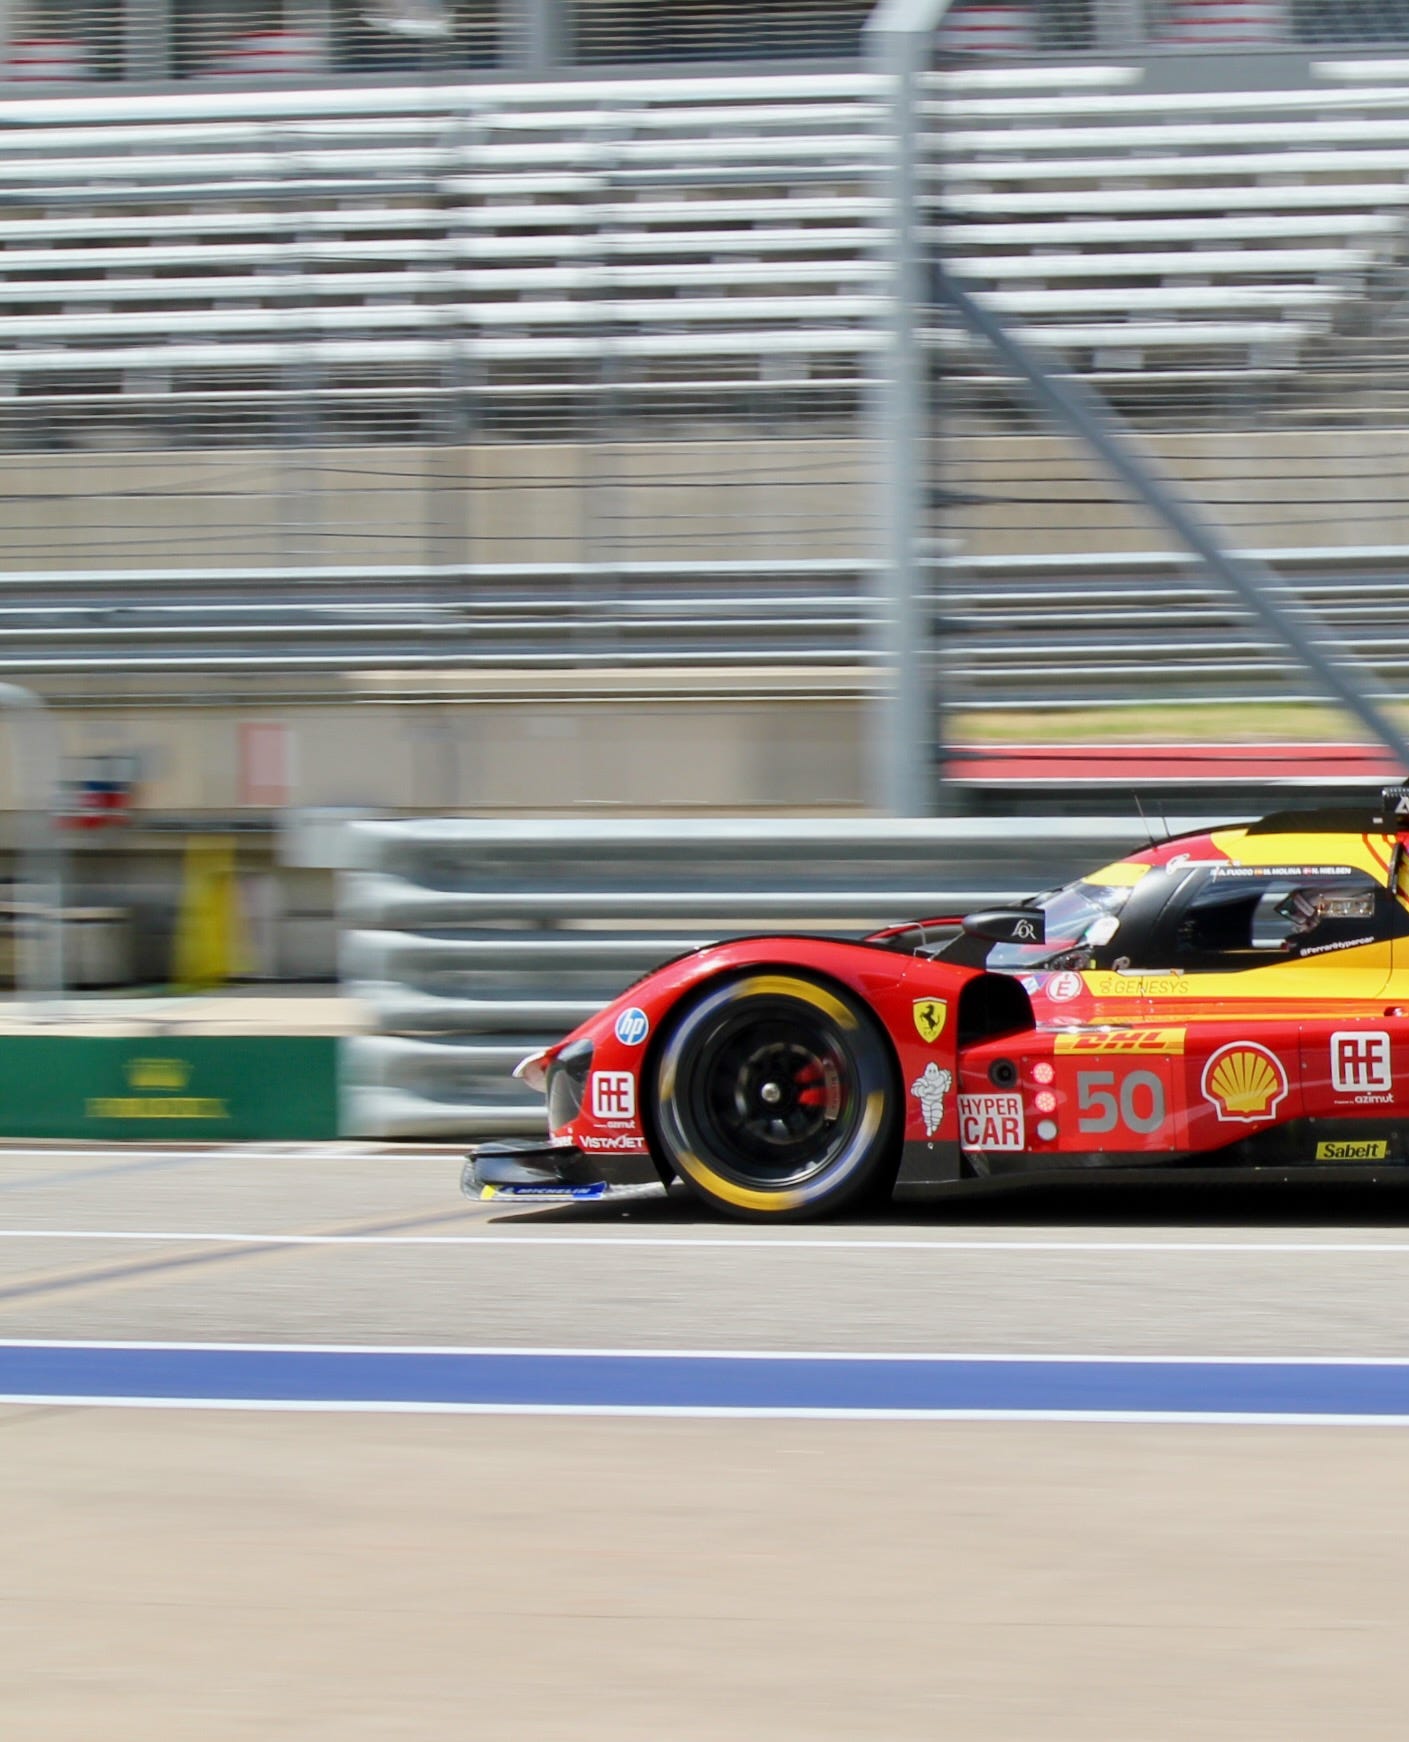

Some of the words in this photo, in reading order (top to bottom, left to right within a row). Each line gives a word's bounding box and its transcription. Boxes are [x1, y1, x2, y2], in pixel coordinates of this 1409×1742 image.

[1115, 980, 1189, 995] GENESYS
[618, 1008, 646, 1044] hp
[1071, 1032, 1168, 1049] DHL
[961, 1097, 1019, 1116] HYPER
[1077, 1069, 1165, 1134] 50
[1354, 1091, 1394, 1104] azimut
[963, 1116, 1021, 1146] CAR
[1323, 1143, 1380, 1158] Sabelt
